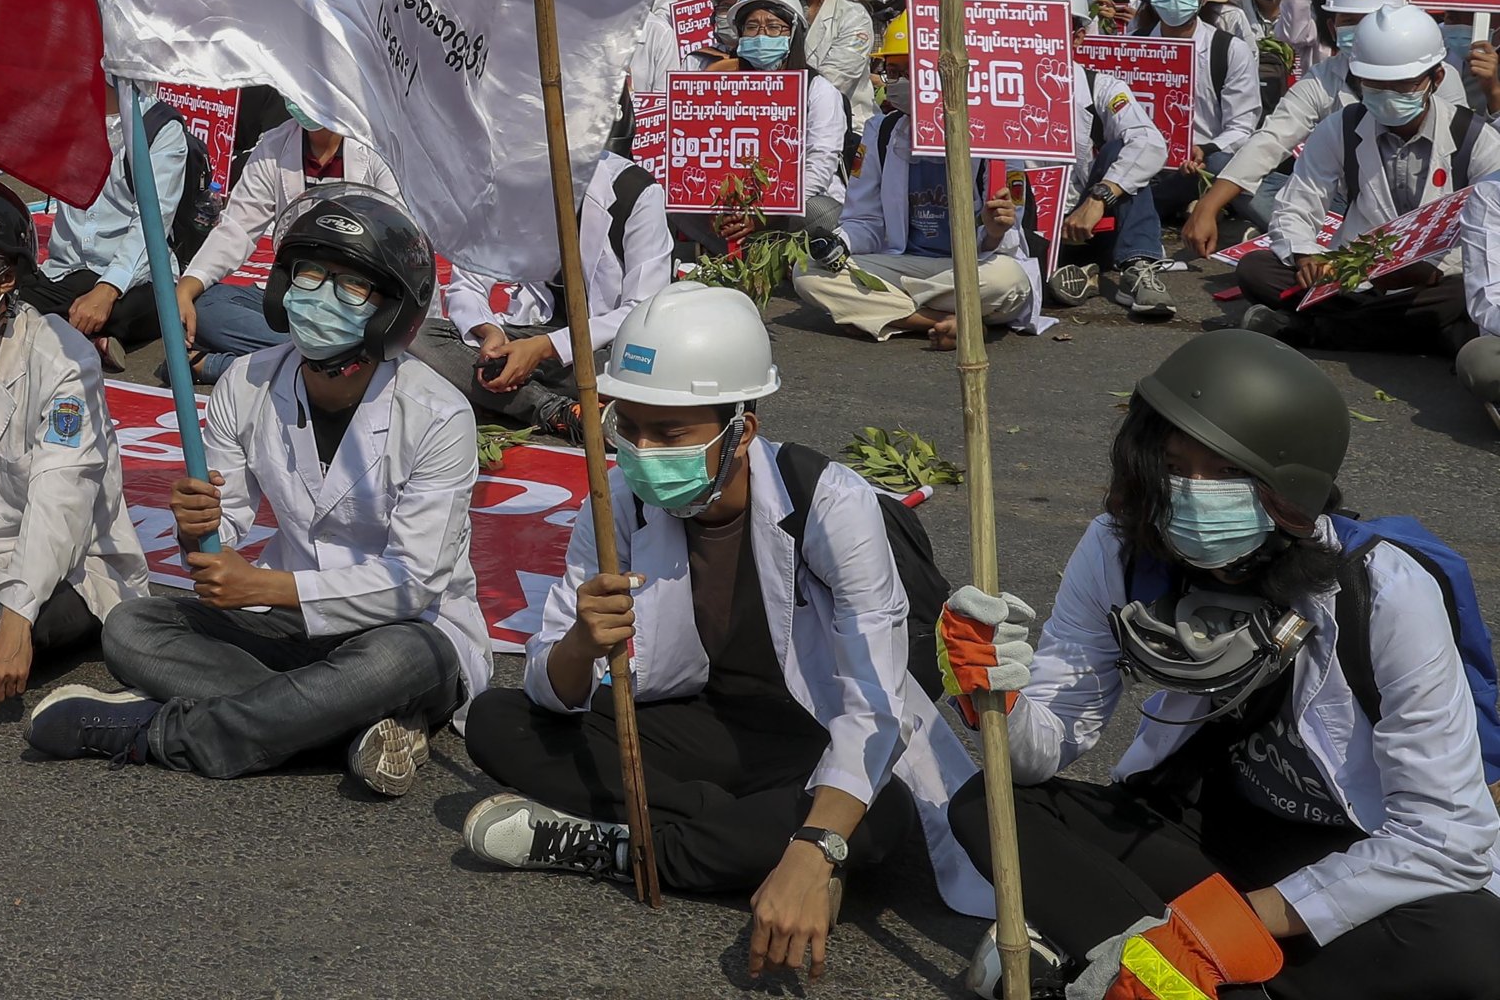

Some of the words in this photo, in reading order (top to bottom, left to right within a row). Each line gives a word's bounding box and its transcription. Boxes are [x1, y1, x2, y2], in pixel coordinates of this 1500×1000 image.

[966, 3, 1047, 27] ရပ်ကွက်အလိုက်
[713, 76, 784, 97] ရပ်ကွက်အလိုက်
[624, 352, 652, 365] Pharmacy
